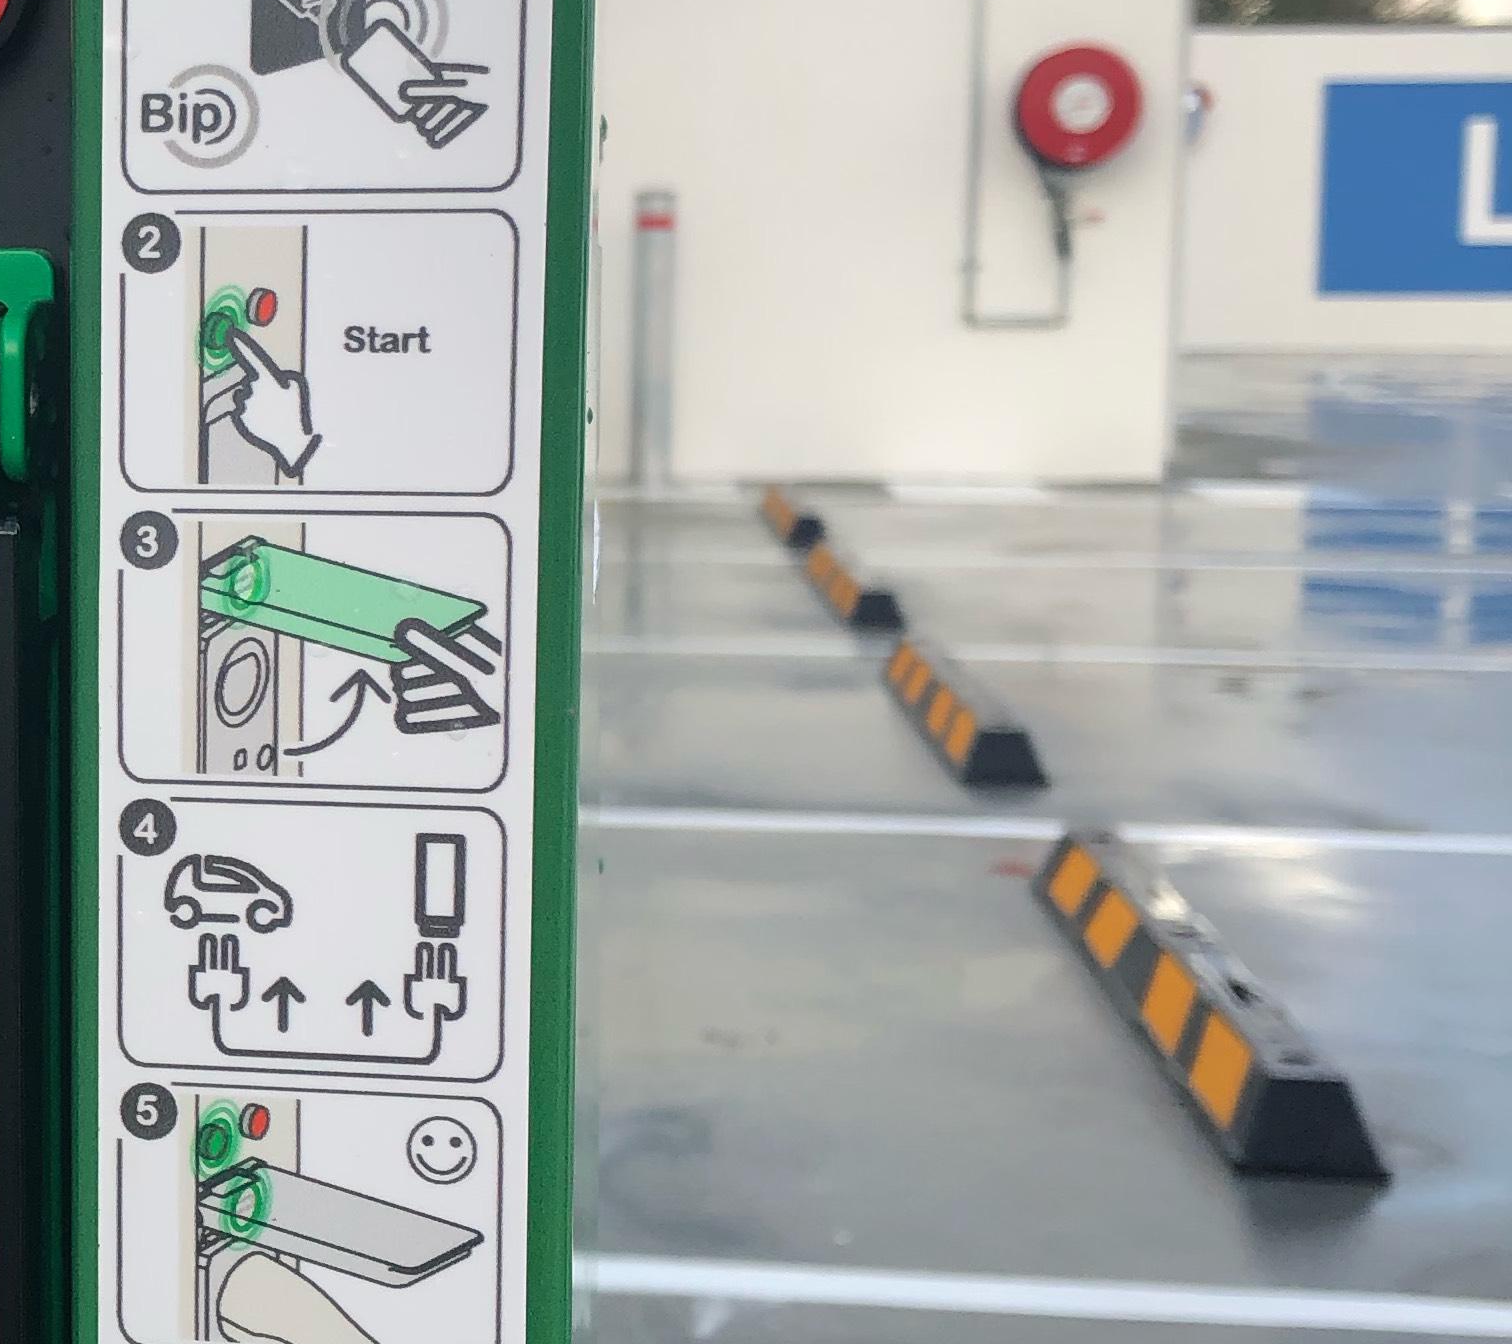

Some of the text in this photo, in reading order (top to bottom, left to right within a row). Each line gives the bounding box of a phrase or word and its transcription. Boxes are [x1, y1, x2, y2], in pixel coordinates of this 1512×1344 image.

[140, 92, 222, 144] Bip
[137, 225, 161, 259] 2
[343, 325, 432, 355] Start
[135, 525, 159, 558] 3
[132, 812, 159, 845] 4
[135, 1094, 159, 1126] 5
